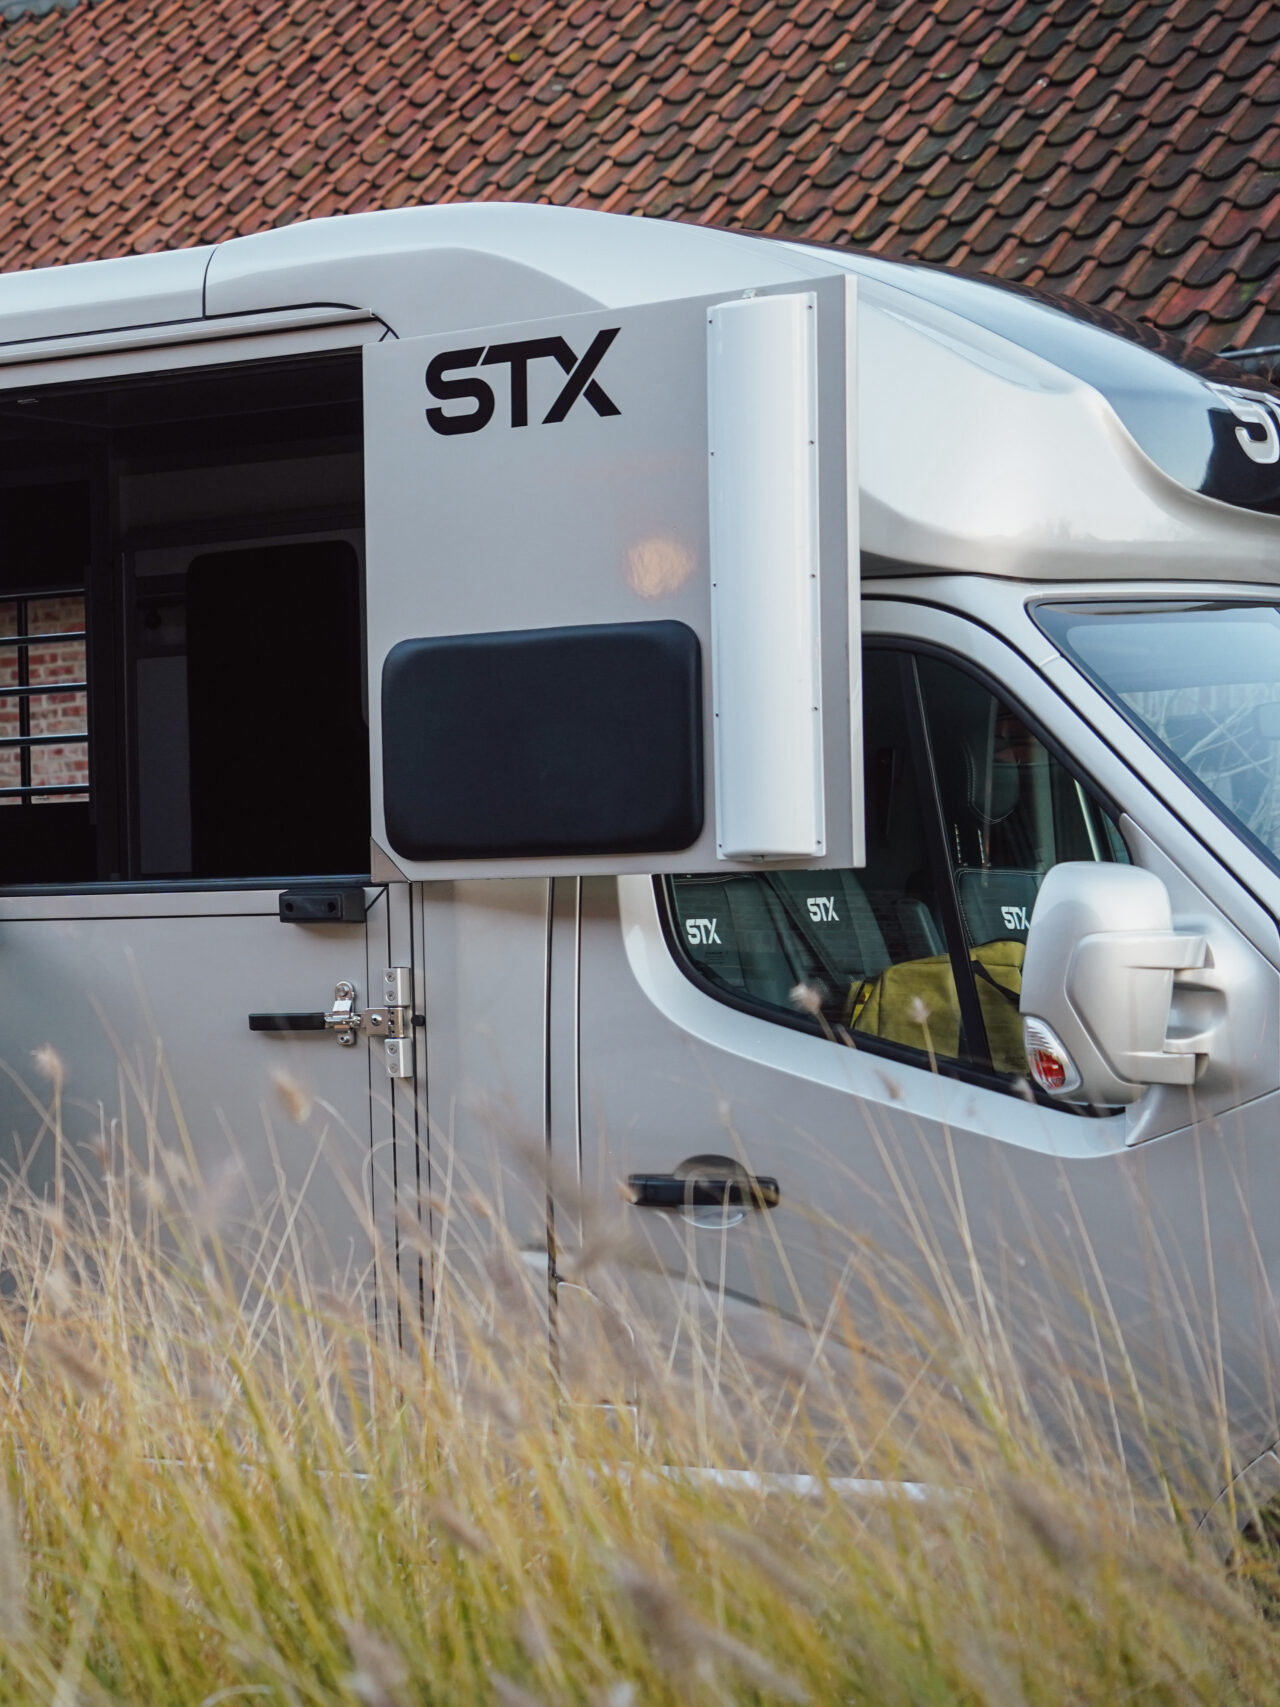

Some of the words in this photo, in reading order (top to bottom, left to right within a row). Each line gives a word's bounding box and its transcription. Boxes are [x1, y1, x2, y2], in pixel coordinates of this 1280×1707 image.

[426, 327, 622, 436] STX
[807, 896, 840, 922] STX
[1001, 906, 1030, 930] STX
[685, 918, 722, 945] STX
